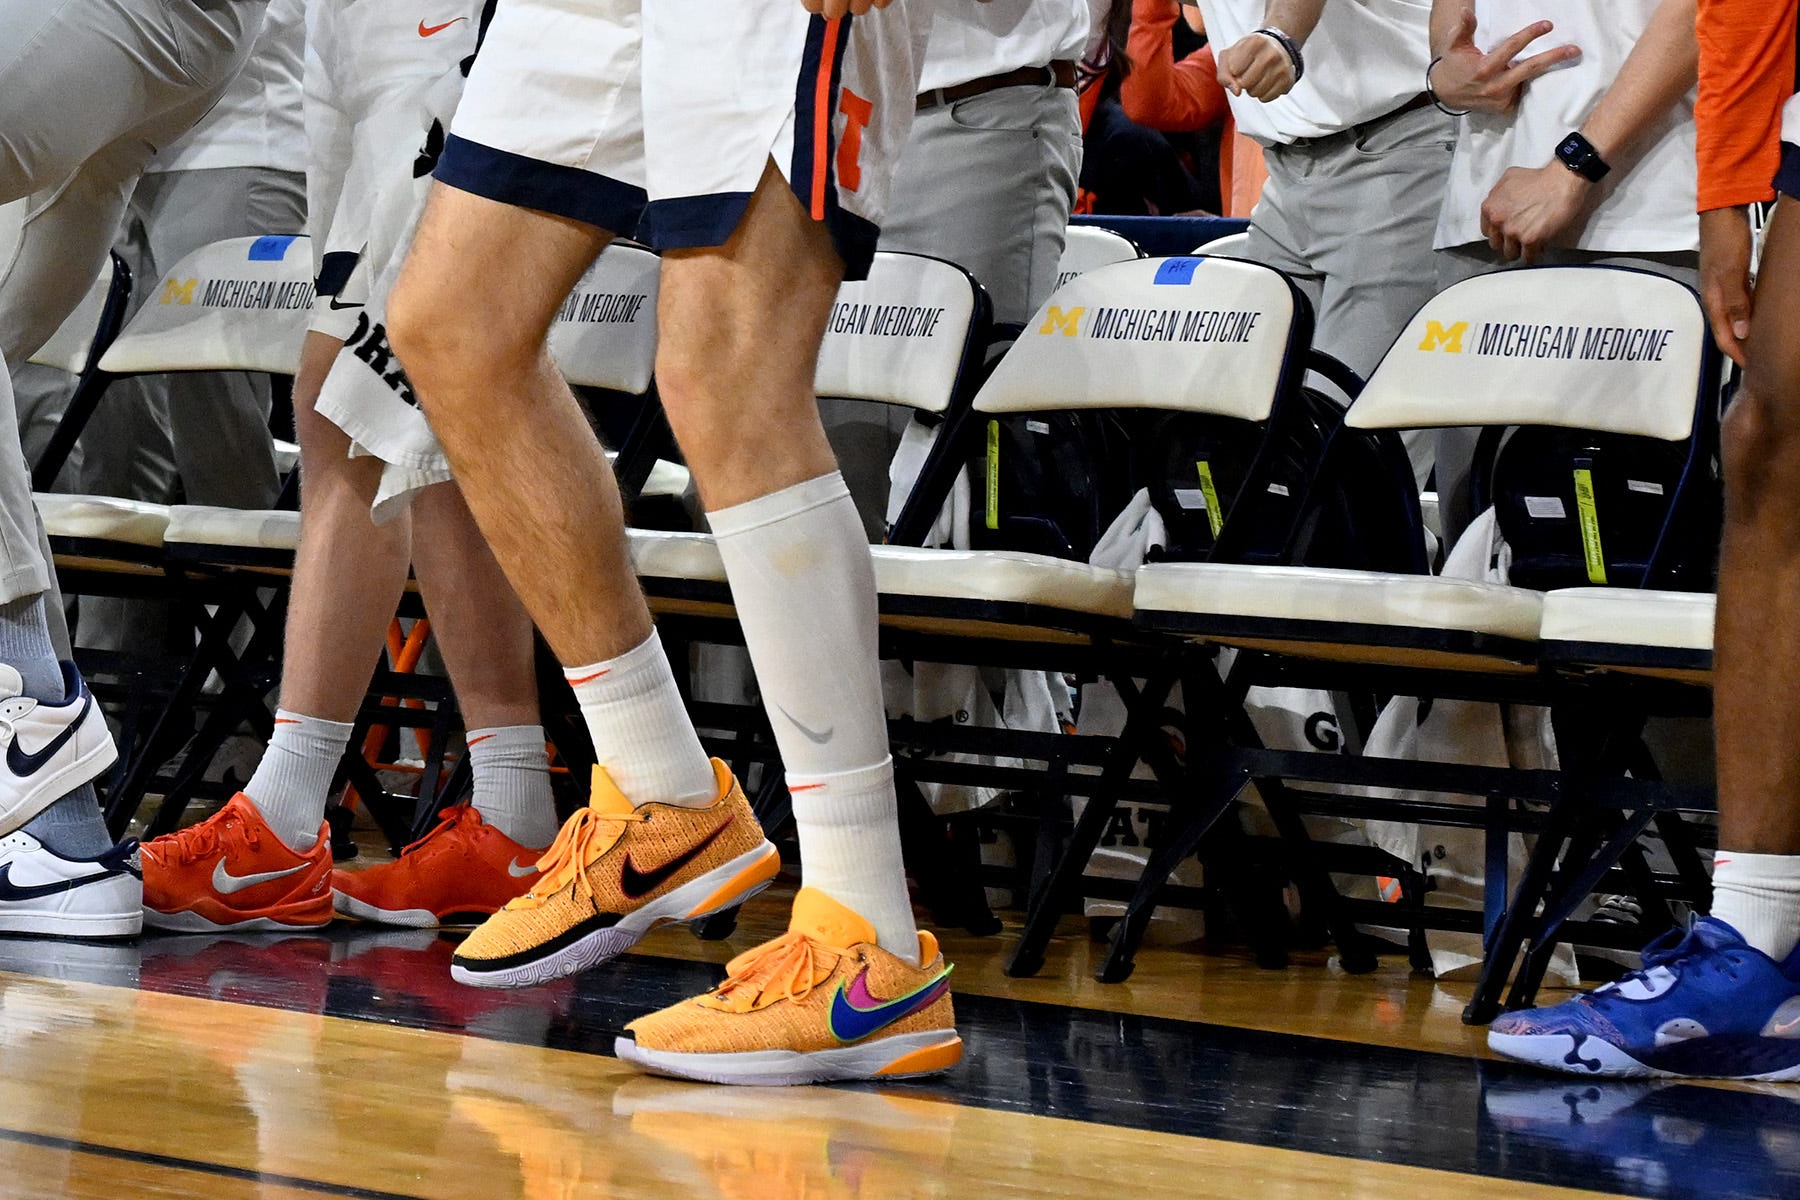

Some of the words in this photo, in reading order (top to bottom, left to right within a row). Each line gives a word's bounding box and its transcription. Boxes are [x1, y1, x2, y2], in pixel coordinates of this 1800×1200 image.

[202, 279, 273, 309] MICHIGAN
[273, 281, 314, 310] MEDIC
[577, 294, 648, 323] MEDICINE
[869, 305, 945, 338] MEDICINE
[1091, 307, 1181, 342] MICHIGAN
[1179, 310, 1262, 343] MEDICINE
[1478, 323, 1580, 360] MICHIGAN
[1579, 327, 1674, 362] MEDICINE
